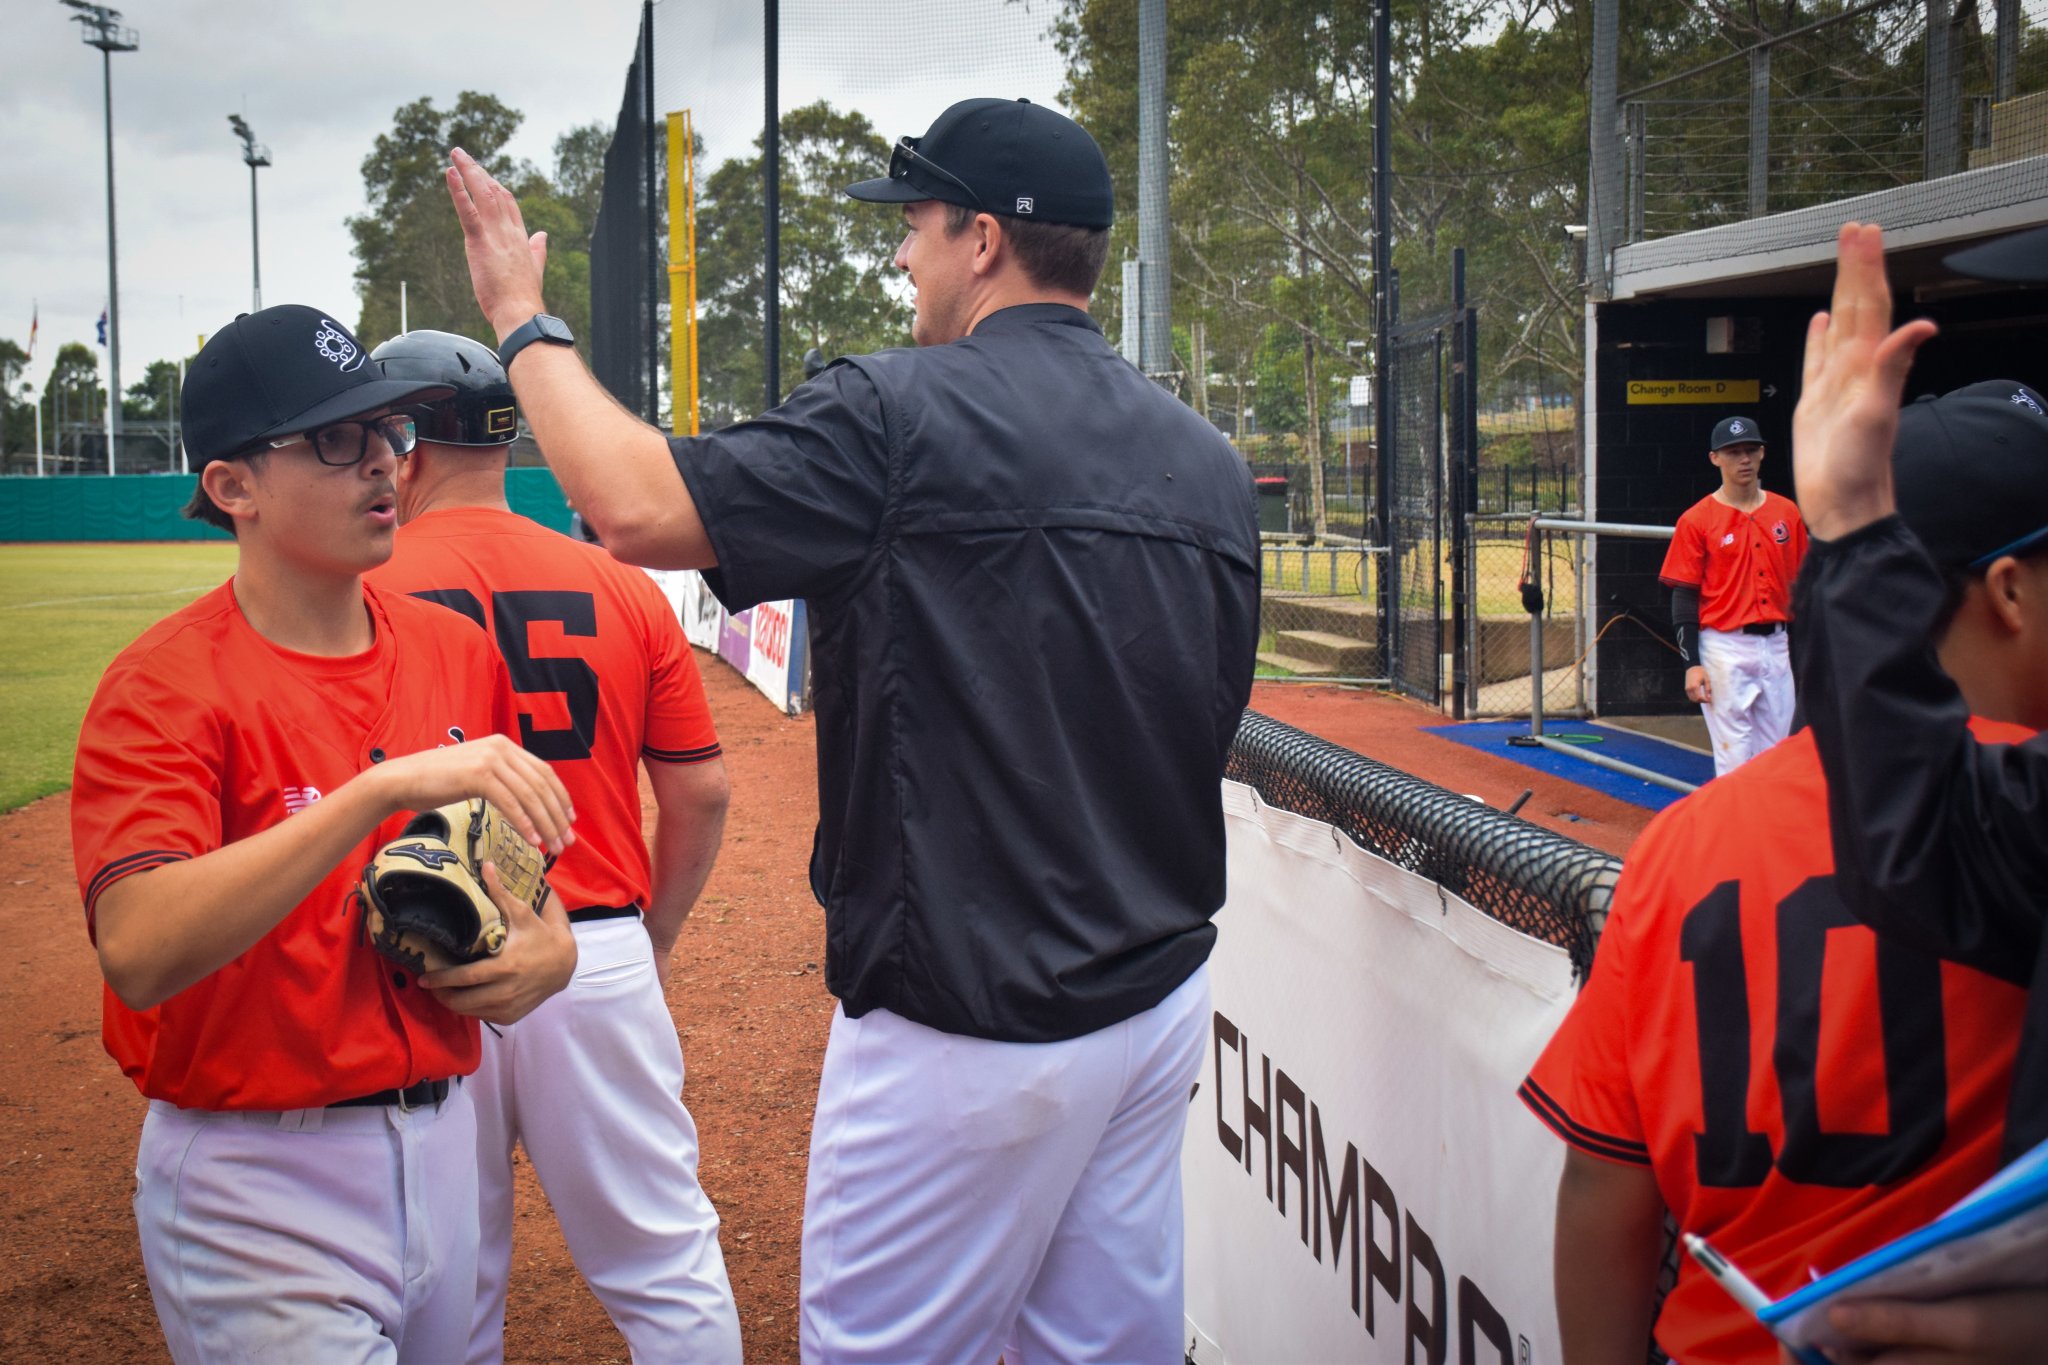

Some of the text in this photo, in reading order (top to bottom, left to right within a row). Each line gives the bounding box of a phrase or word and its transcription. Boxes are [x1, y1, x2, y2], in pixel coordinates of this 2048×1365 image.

[1630, 382, 1726, 397] Change Room D
[1680, 874, 1948, 1188] 10
